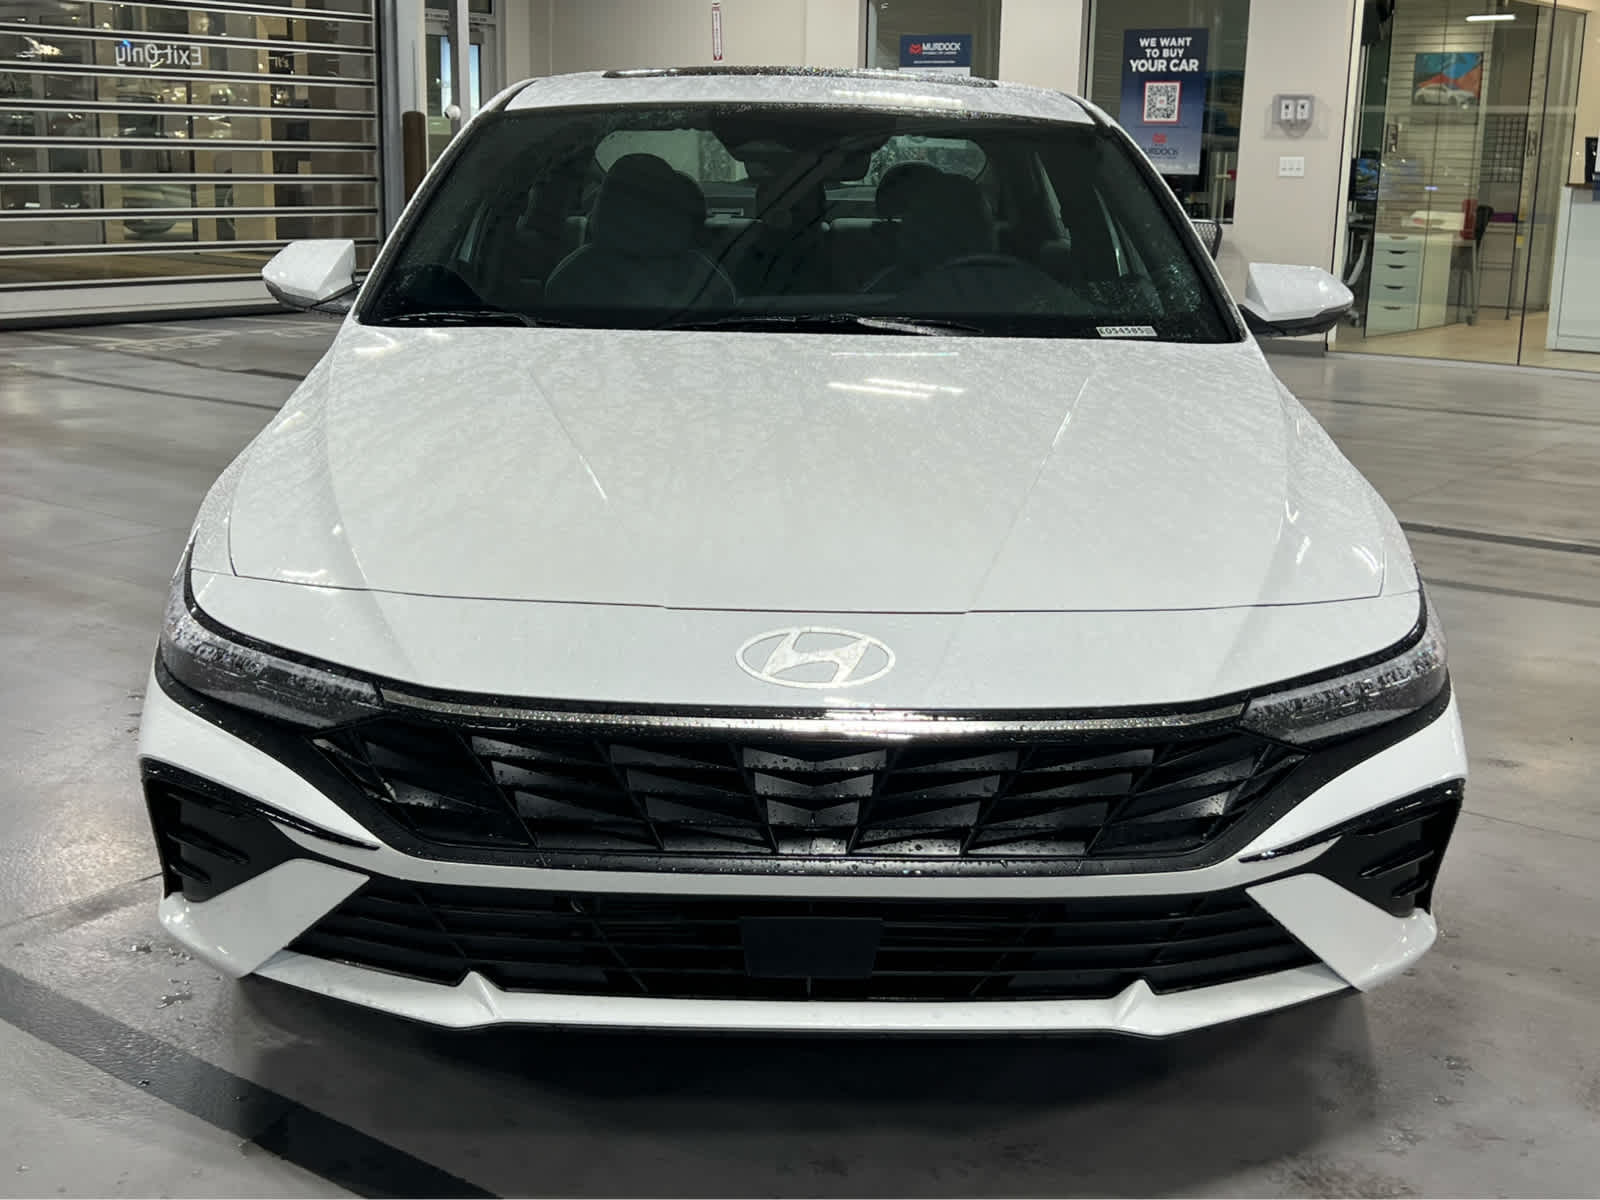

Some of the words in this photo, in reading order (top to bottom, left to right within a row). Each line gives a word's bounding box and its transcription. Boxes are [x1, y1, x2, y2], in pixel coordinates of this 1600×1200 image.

[922, 42, 961, 51] MURDOCK
[1139, 37, 1157, 47] WE
[1159, 36, 1192, 47] WANT
[1145, 48, 1160, 58] TO
[1162, 48, 1185, 58] BUY
[1129, 59, 1168, 72] YOUR
[1169, 58, 1199, 72] CAR
